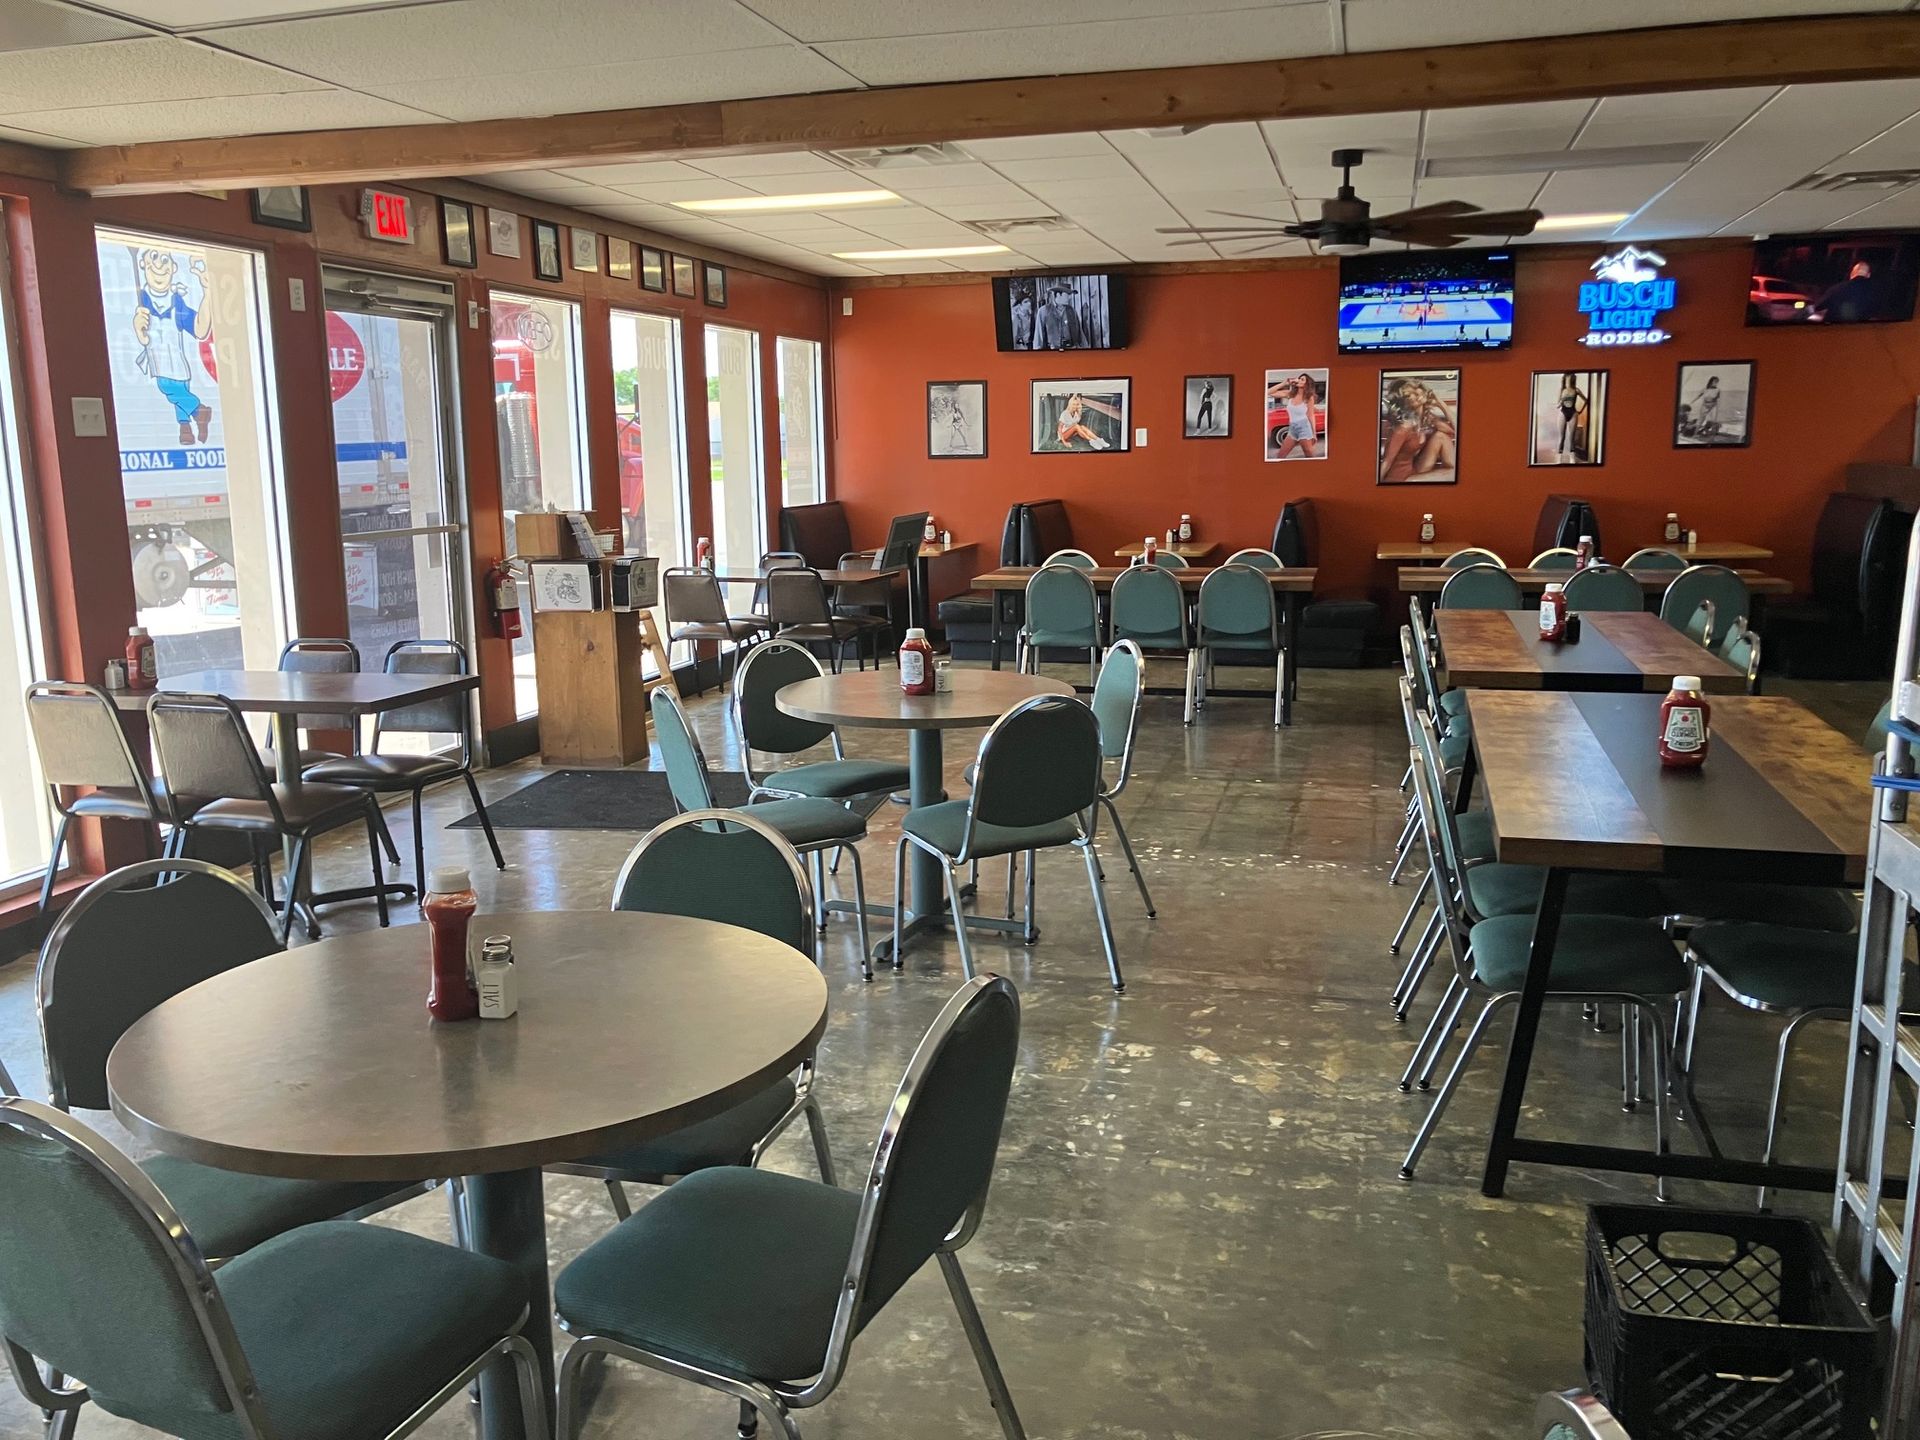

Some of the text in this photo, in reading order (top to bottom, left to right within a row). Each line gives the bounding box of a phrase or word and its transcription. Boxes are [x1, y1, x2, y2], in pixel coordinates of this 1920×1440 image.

[374, 191, 408, 239] EXIT
[1579, 280, 1675, 311] BUSCH
[1589, 309, 1657, 330] LIGHT
[1585, 330, 1664, 346] RODEO
[329, 347, 359, 371] LE
[483, 984, 498, 1007] SALT
